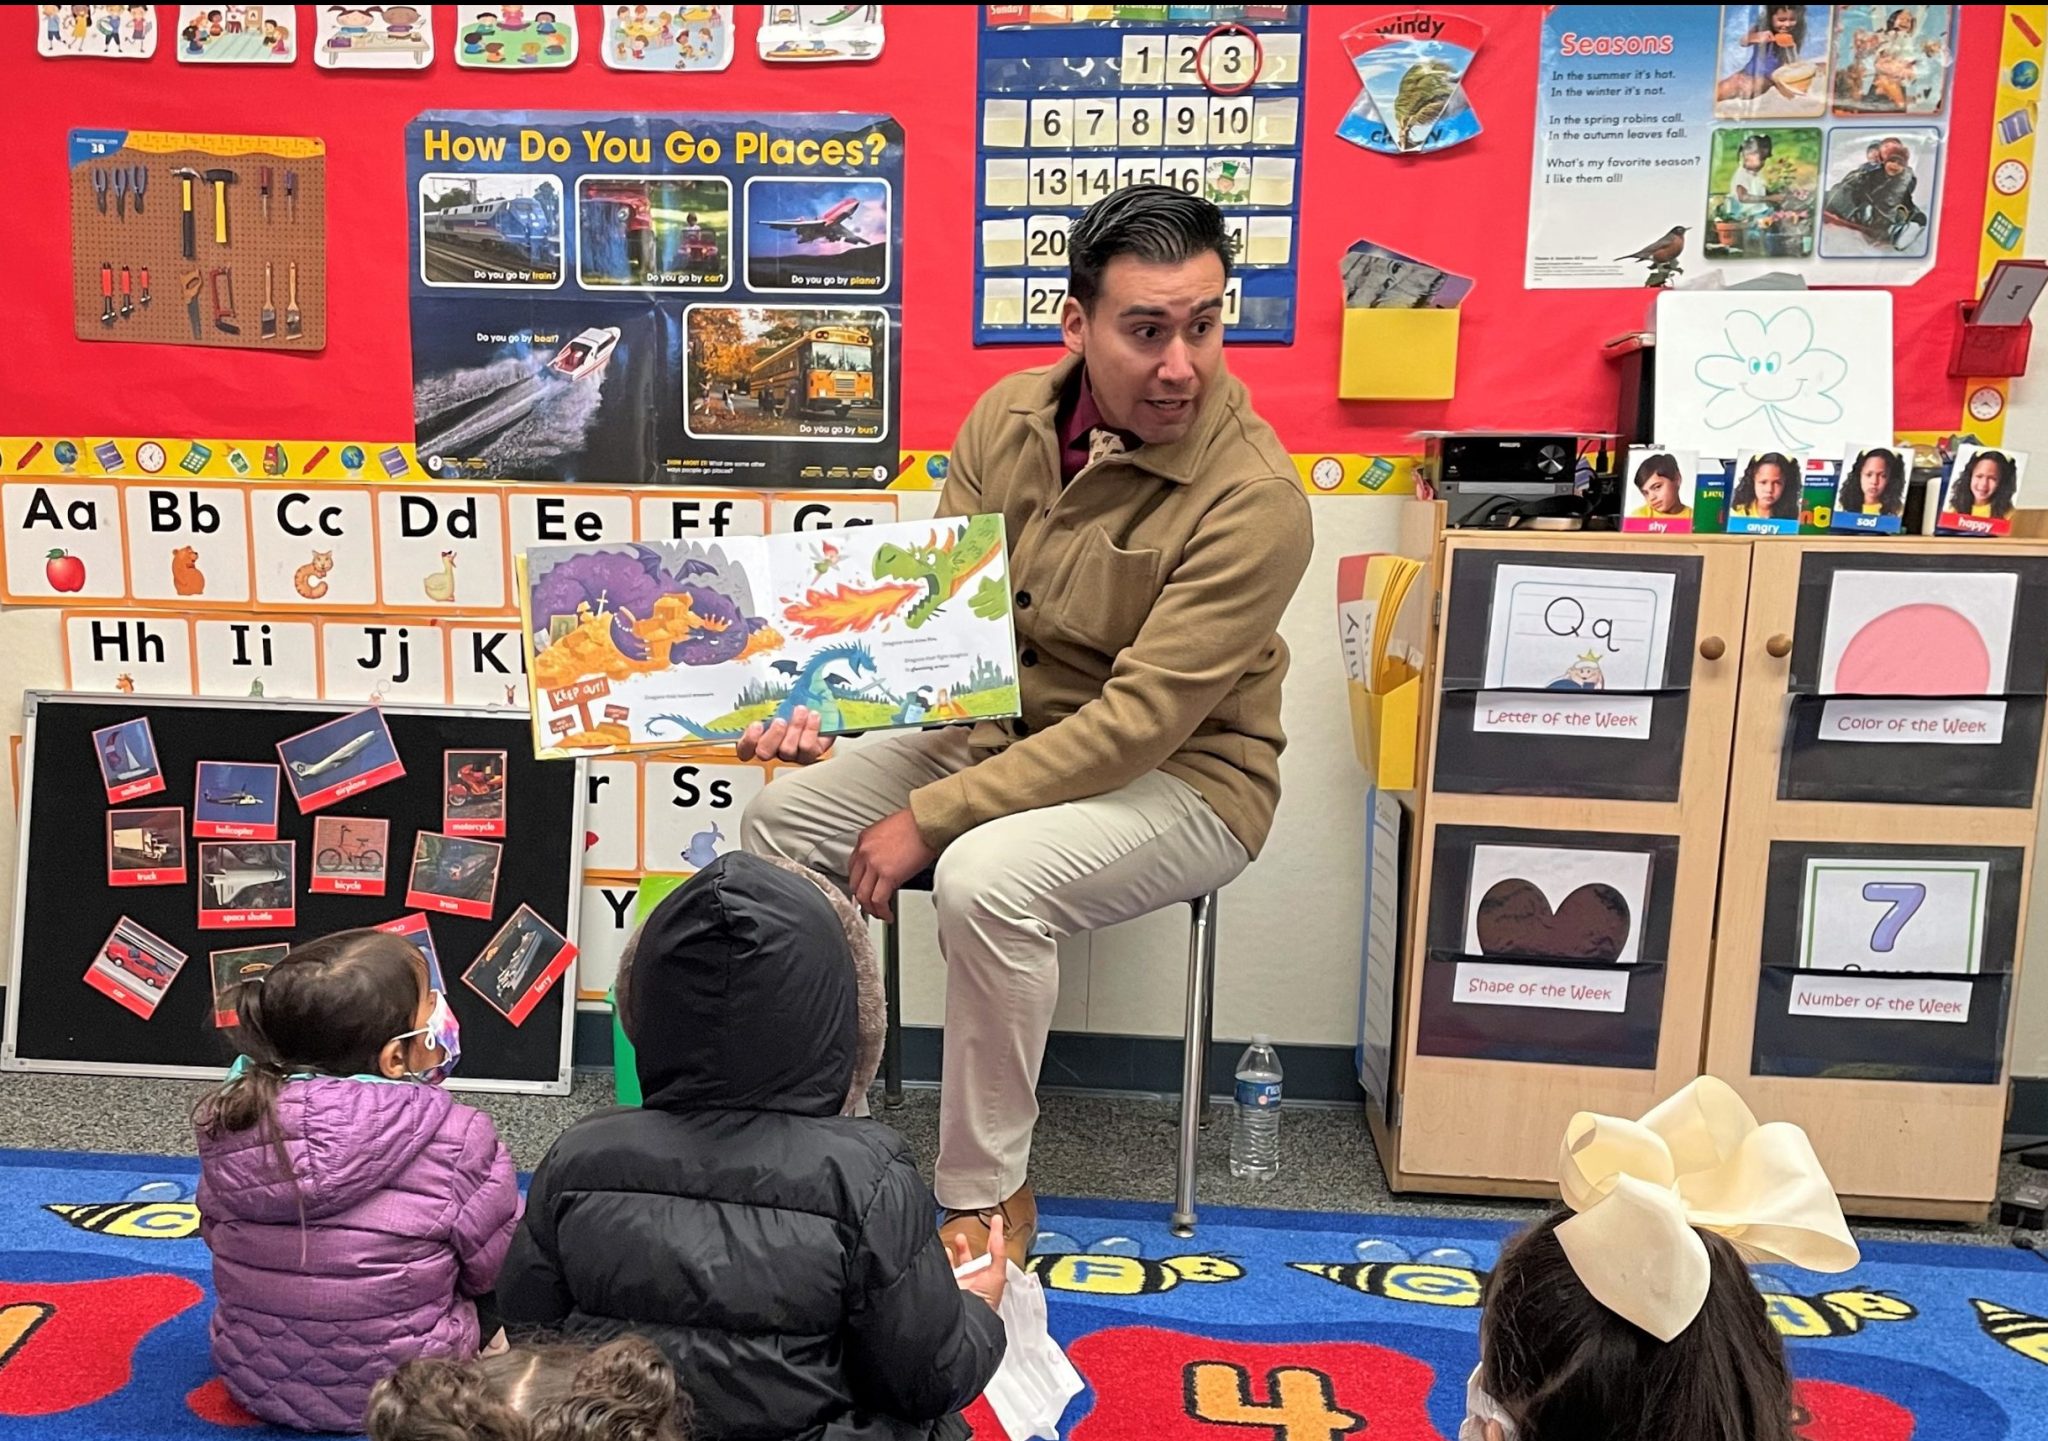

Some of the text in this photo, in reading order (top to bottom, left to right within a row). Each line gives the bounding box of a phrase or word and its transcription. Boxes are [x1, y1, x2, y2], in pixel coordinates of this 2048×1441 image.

[1376, 15, 1444, 39] windy
[1561, 32, 1673, 56] Seasons
[1137, 46, 1241, 74] 1 2 3
[1552, 69, 1676, 81] In the summer it's hot.
[1551, 86, 1666, 97] In the winter it's not.
[1043, 106, 1248, 137] 6 7 8 9 10
[1549, 113, 1684, 126] In the spring robins call.
[1548, 128, 1687, 141] In the autumn leaves fall.
[91, 143, 105, 154] 38
[425, 129, 887, 166] How Do You Go Places?
[1547, 156, 1701, 169] What's my favorite season?
[1033, 168, 1067, 195] 13
[1077, 168, 1110, 195] 14
[1165, 168, 1199, 195] 16
[1545, 173, 1623, 184] I like them all!
[1031, 228, 1244, 256] 20 4
[474, 270, 557, 282] Do you go by train?
[647, 273, 659, 282] Do
[660, 274, 677, 284] you
[678, 275, 690, 284] go
[691, 273, 703, 284] by
[791, 275, 804, 284] Do
[805, 277, 822, 286] you
[823, 277, 836, 287] go
[836, 276, 849, 286] by
[1030, 288, 1236, 315] 27 1
[477, 333, 489, 342] Do
[490, 335, 507, 343] you
[508, 335, 520, 344] go
[520, 334, 533, 344] by
[800, 424, 812, 433] Do
[813, 426, 830, 435] you
[831, 426, 843, 435] go
[844, 425, 856, 435] by
[22, 488, 97, 531] Aa
[149, 490, 221, 534] Bb
[277, 492, 344, 537] Cc
[401, 496, 477, 538] Dd
[537, 498, 603, 542] Ee
[672, 501, 733, 540] Ff
[1648, 521, 1668, 533] shy
[1747, 522, 1780, 534] angry
[1857, 515, 1878, 528] sad
[1958, 517, 1993, 533] happy
[91, 620, 165, 663] Hh
[230, 624, 273, 666] Ii
[357, 627, 409, 683] Jj
[472, 632, 527, 674] K
[552, 679, 605, 705] KEEP OUT!
[1486, 710, 1638, 729] Letter of the Week
[1837, 716, 1987, 735] Color of the Week
[335, 778, 367, 798] airplane
[588, 774, 610, 804] r
[672, 765, 733, 809] Ss
[215, 824, 255, 837] helicopter
[452, 822, 496, 833] motorcycle
[136, 872, 158, 882] truck
[334, 880, 362, 892] bicycle
[439, 899, 459, 911] train
[601, 889, 638, 929] Y
[222, 911, 273, 923] space shuttle
[1862, 881, 1927, 953] 7
[111, 988, 127, 1001] car
[533, 974, 553, 995] ferry
[1469, 977, 1612, 1000] Shape of the Week
[1797, 992, 1963, 1014] Number of the Week
[133, 1211, 196, 1230] C
[1072, 1260, 1126, 1284] F
[1390, 1272, 1483, 1297] G
[1182, 1360, 1368, 1441] 4
